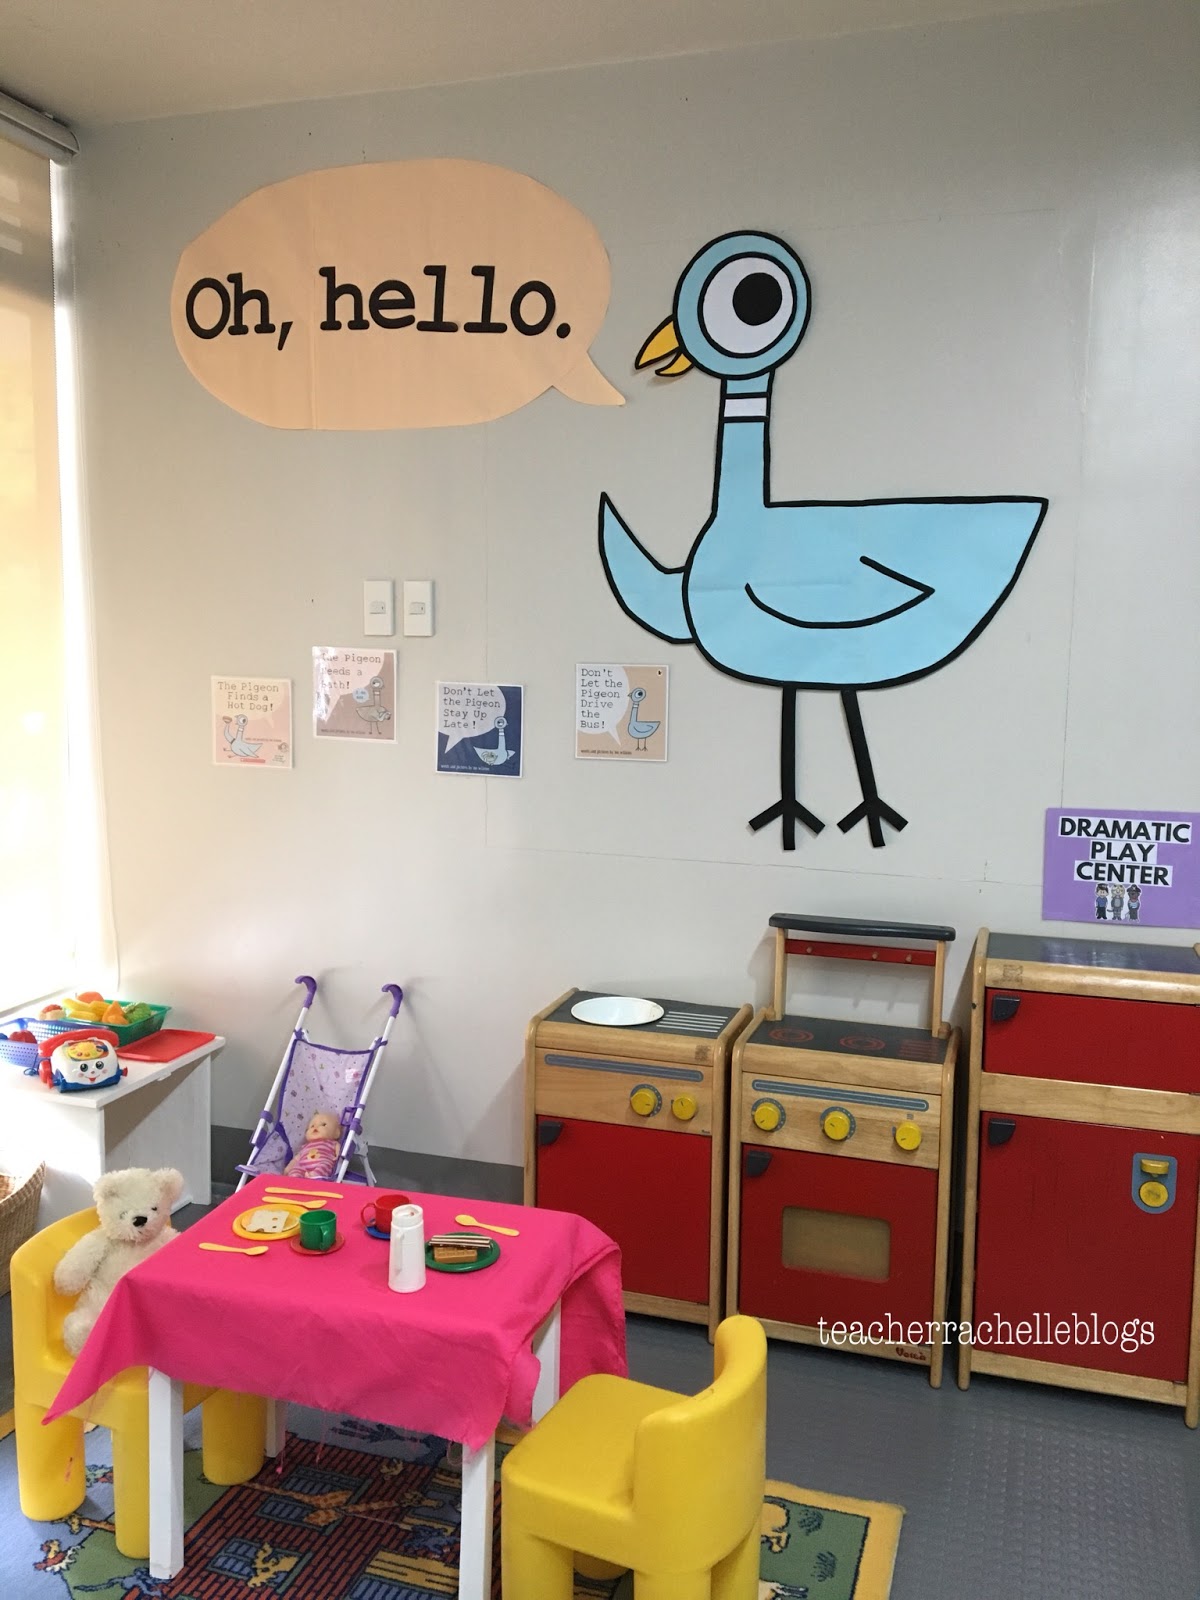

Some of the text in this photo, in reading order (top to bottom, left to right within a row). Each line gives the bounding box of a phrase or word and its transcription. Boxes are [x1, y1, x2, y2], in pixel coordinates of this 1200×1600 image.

[186, 265, 571, 351] Oh, hello.
[345, 653, 381, 664] Pigeon
[581, 668, 613, 677] Don't
[218, 681, 279, 693] The Pigeon
[581, 679, 623, 688] Let the
[227, 691, 269, 702] Finds a
[443, 686, 495, 697] Don't Let
[581, 689, 620, 700] Pigeon
[227, 701, 273, 713] Hot Dog!
[443, 697, 501, 710] the Pigeon
[581, 699, 614, 709] Drive
[443, 708, 488, 721] Stay Up
[581, 710, 600, 719] the
[443, 719, 476, 729] Late!
[580, 720, 605, 729] Bus!
[1060, 817, 1191, 843] DRAMATIC
[1091, 841, 1155, 862] PLAY
[1076, 861, 1170, 886] CENTER
